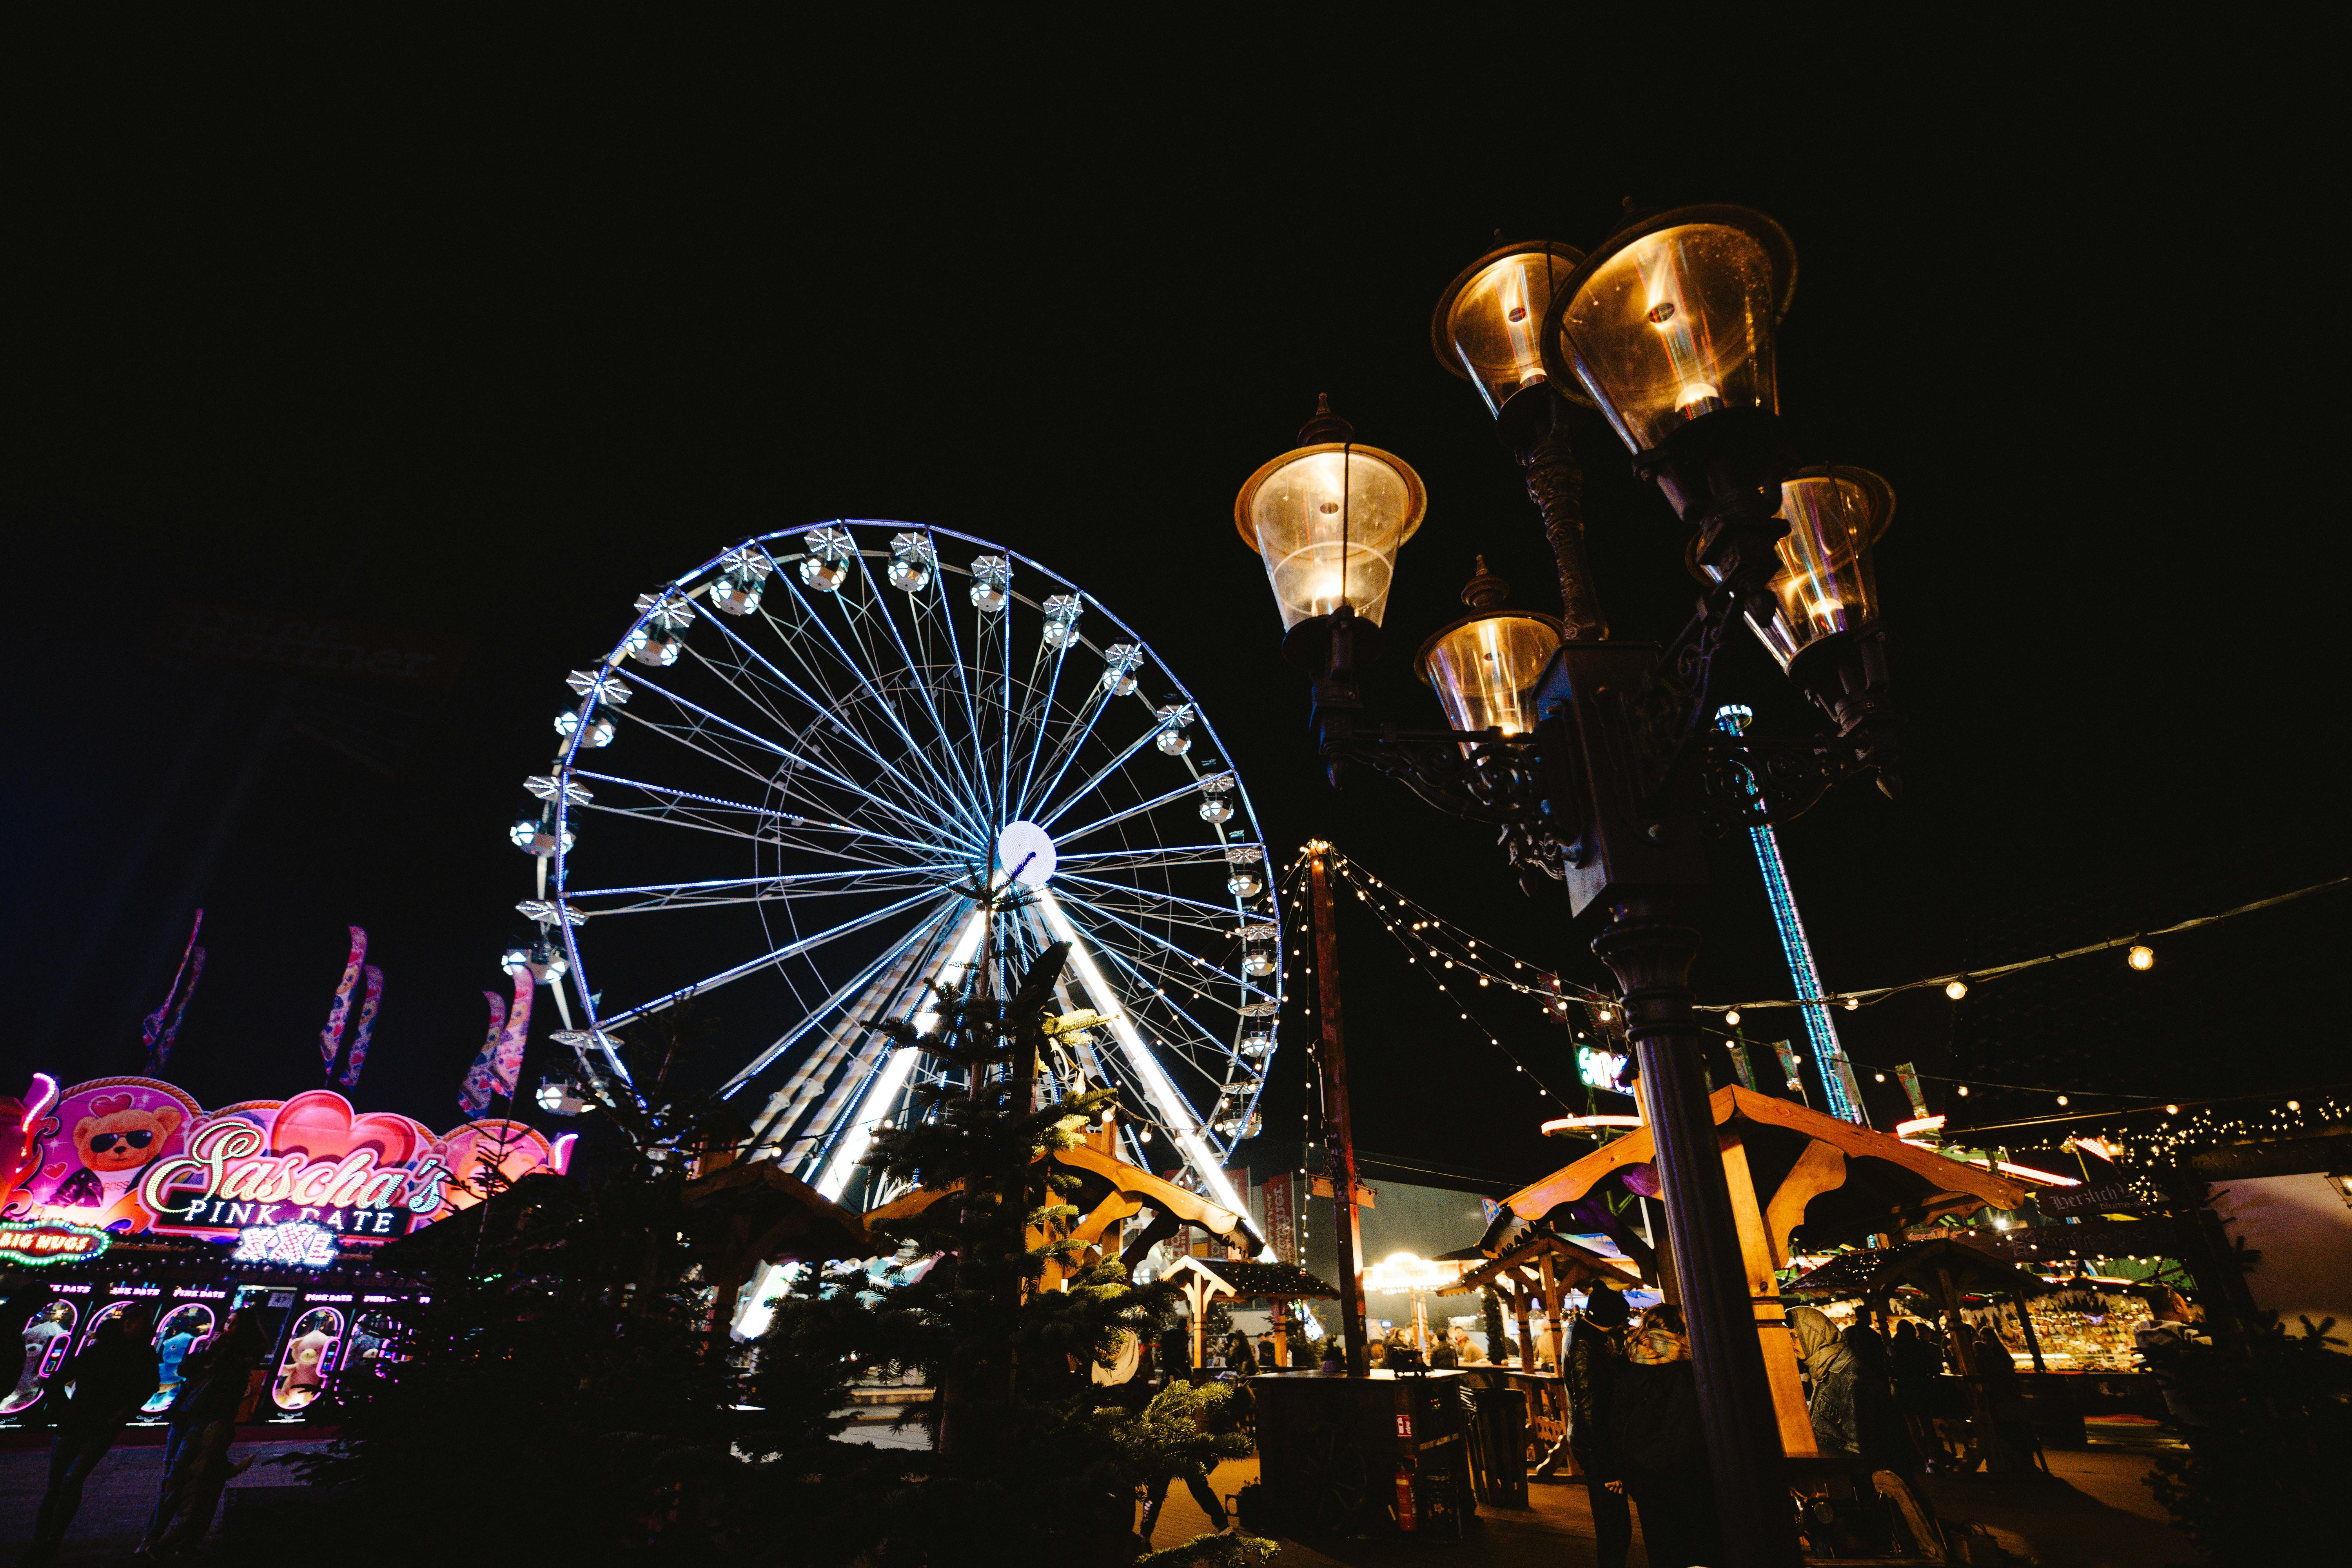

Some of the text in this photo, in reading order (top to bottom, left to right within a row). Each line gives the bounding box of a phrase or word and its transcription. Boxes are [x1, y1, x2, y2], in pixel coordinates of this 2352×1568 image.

[146, 1122, 446, 1213] Sascha's
[184, 1200, 394, 1232] PINK DATE
[0, 1232, 90, 1252] BIG HUGS
[234, 1221, 336, 1265] XXL
